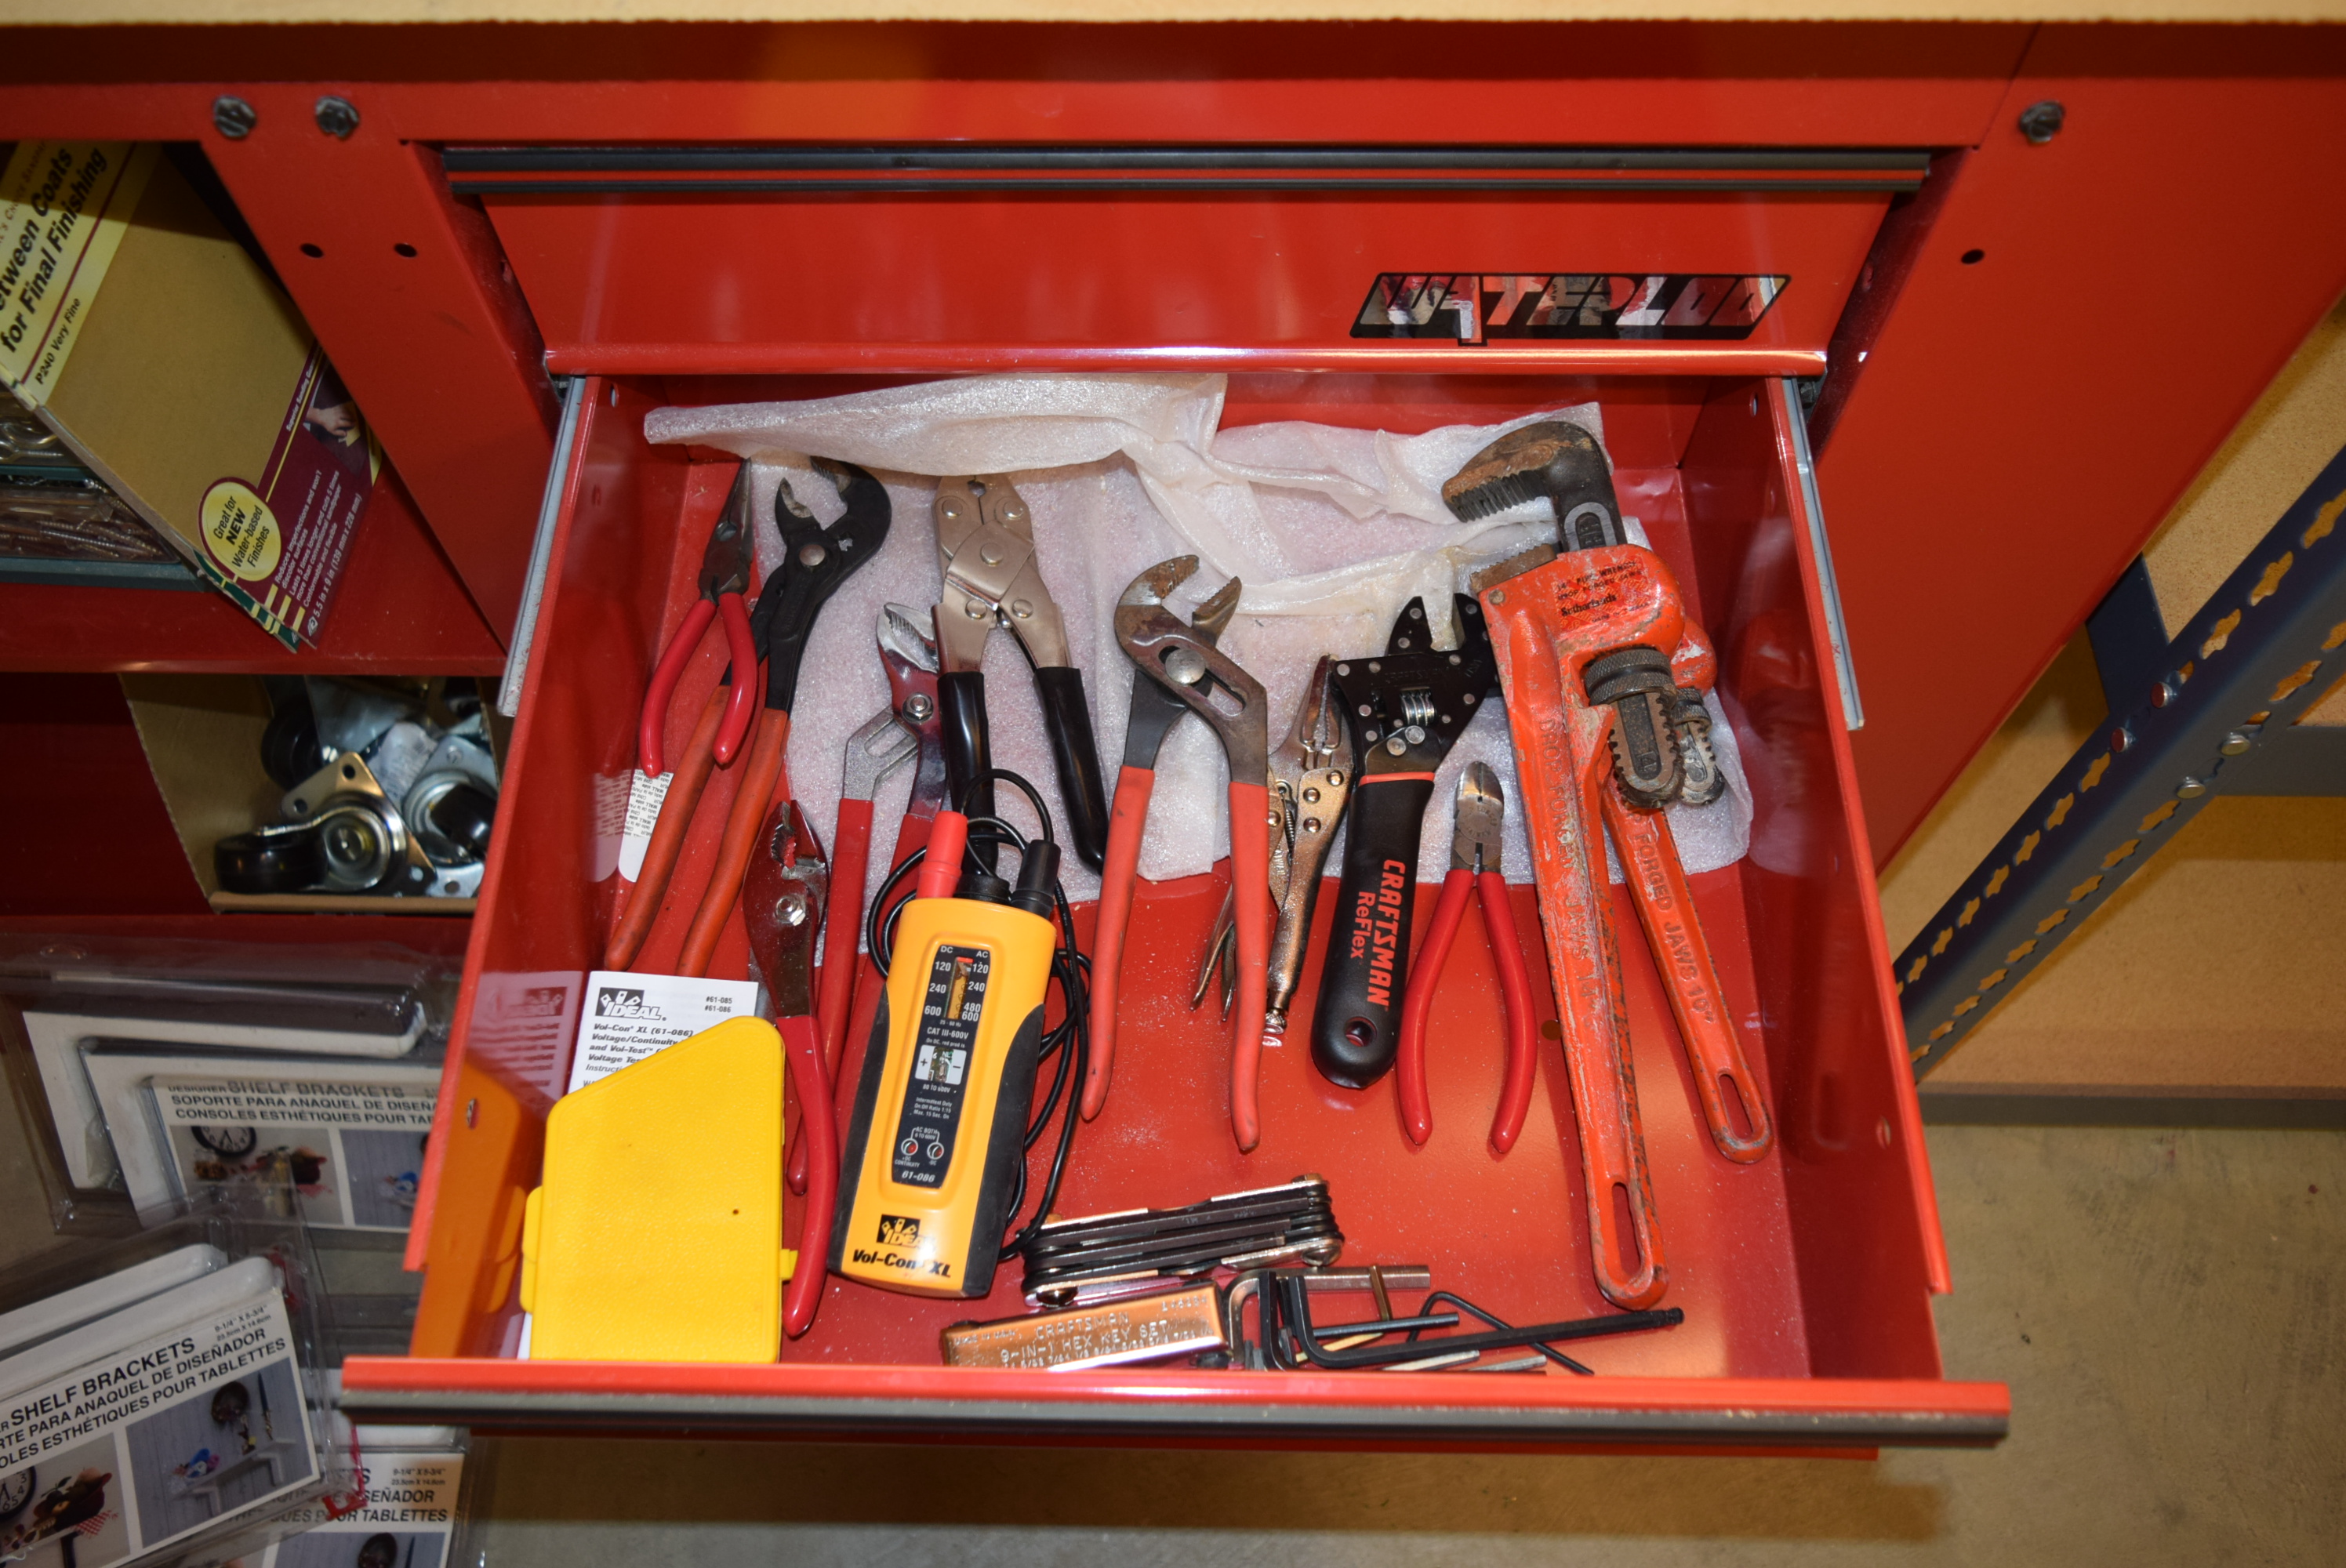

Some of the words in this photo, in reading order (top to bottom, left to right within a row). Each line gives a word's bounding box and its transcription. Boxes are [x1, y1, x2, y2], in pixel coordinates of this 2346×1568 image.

[31, 148, 72, 217] Coats
[0, 311, 27, 353] for
[19, 247, 56, 314] Final
[46, 147, 107, 253] Finishing
[1356, 274, 1790, 346] WATERLOO
[34, 352, 55, 384] P240
[50, 324, 69, 350] Very
[64, 298, 80, 324] Fine
[285, 403, 299, 431] Superior
[296, 378, 310, 404] Sanding
[351, 493, 362, 513] mm)
[212, 510, 231, 539] Great
[224, 495, 237, 512] for
[225, 507, 245, 546] NEW
[344, 511, 354, 528] 228
[231, 504, 263, 568] Water-based
[246, 525, 270, 568] Finishes
[274, 551, 291, 583] Reduces
[287, 504, 309, 552] imperfections
[289, 575, 301, 596] Lasts
[300, 549, 310, 569] times
[330, 550, 342, 570] (139
[281, 558, 296, 589] discolor
[296, 581, 307, 601] more
[303, 564, 313, 582] than
[303, 562, 323, 607] Conformable
[326, 568, 335, 578] in
[313, 601, 323, 618] 5.5
[318, 592, 326, 602] in
[1635, 833, 1672, 911] FORGED
[1664, 920, 1698, 981] JAWS
[1349, 891, 1376, 960] ReFlex
[1367, 858, 1406, 1007] CRAFTSMAN
[935, 960, 951, 971] 120
[972, 963, 989, 974] 120
[928, 982, 946, 993] 240
[968, 981, 985, 992] 240
[604, 1001, 663, 1021] IDEAL
[706, 996, 732, 1004] #61-085
[705, 1005, 732, 1014] #61-086
[924, 1005, 942, 1016] 600
[961, 1010, 979, 1022] 600
[963, 1002, 981, 1013] 480
[651, 1027, 693, 1038] (61-086)
[927, 1026, 941, 1035] CAT
[941, 1029, 969, 1040] III-600V
[586, 1064, 623, 1073] Instructi
[588, 1053, 623, 1063] Voltage
[296, 1082, 405, 1098] BRACKETS
[172, 1095, 243, 1106] SOPORTE
[247, 1098, 286, 1108] PARA
[290, 1098, 362, 1110] ANAQUEL
[364, 1100, 383, 1110] DE
[387, 1099, 438, 1112] DISEÑA
[176, 1109, 257, 1120] CONSOLES
[260, 1109, 362, 1123] ESTHÉTIQUES
[365, 1114, 406, 1123] POUR
[901, 1170, 935, 1182] 61-086
[931, 1262, 950, 1278] XL
[1035, 1312, 1129, 1340] CRAFTSMAN
[1000, 1341, 1054, 1363] 9-IN-1
[1061, 1334, 1093, 1351] HEX
[1100, 1327, 1131, 1344] KEY
[1138, 1319, 1168, 1338] SET
[11, 1385, 77, 1426] SHELF
[82, 1338, 194, 1396] BRACKETS
[29, 1411, 71, 1437] PARA
[74, 1379, 149, 1418] ANAQUEL
[152, 1367, 173, 1385] DE
[176, 1328, 266, 1374] DISEÑADOR
[42, 1396, 150, 1450] ESTHÉTIQUES
[153, 1376, 197, 1403] POUR
[198, 1338, 285, 1383] TABLETTES
[363, 1487, 434, 1503] SEÑADOR
[362, 1509, 448, 1522] TABLETTES
